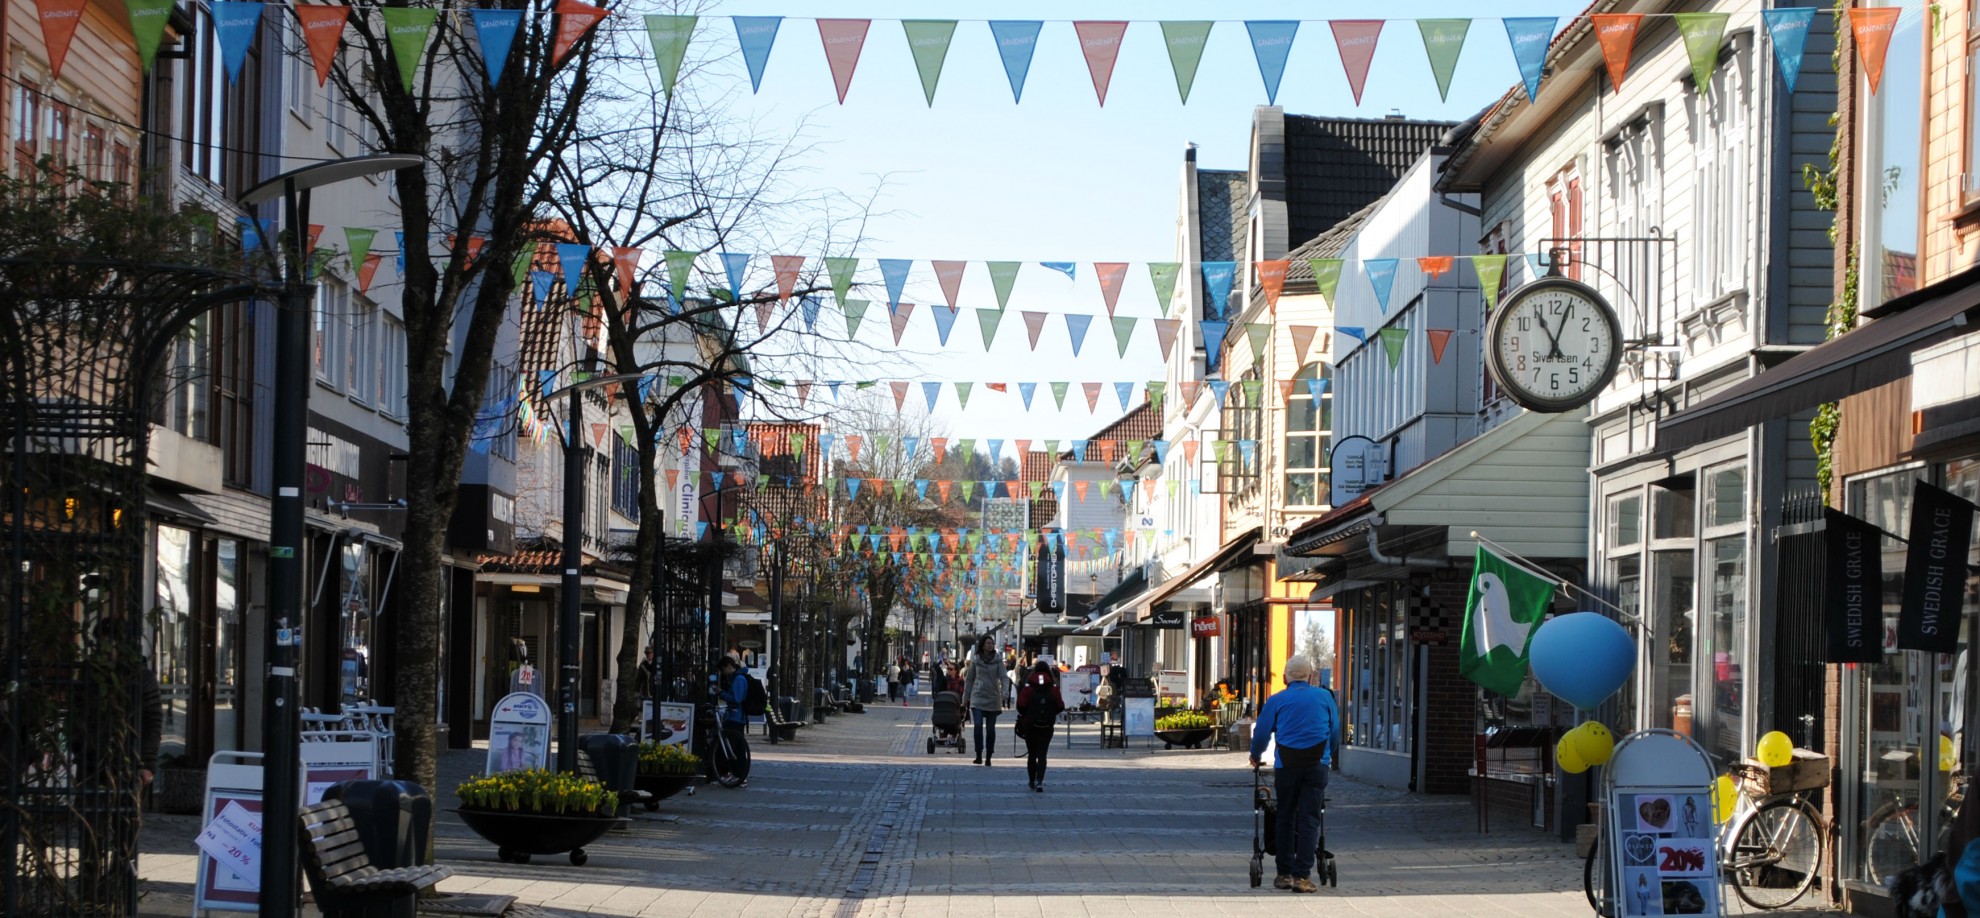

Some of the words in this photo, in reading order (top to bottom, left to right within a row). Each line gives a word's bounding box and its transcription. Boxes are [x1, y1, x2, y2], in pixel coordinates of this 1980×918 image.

[43, 10, 79, 18] SANDNES
[132, 7, 168, 17] SANDNES
[219, 18, 255, 27] SANDNES
[306, 19, 342, 29] SANDNES
[480, 19, 515, 29] SANDNES
[1601, 23, 1635, 33] SANDNES
[1773, 21, 1807, 33] SANDNES
[392, 25, 427, 34] SANDNES
[742, 25, 775, 33] SANDNES
[1687, 28, 1722, 39] SANDNES
[1857, 23, 1892, 34] SANDNES
[827, 35, 863, 44] SANDNES
[914, 37, 948, 46] SANDNES
[1001, 37, 1035, 46] SANDNES
[1085, 38, 1120, 47] SANDNES
[1170, 36, 1205, 45] SANDNES
[1257, 37, 1291, 47] SANDNES
[1341, 36, 1375, 46] SANDNES
[1515, 33, 1549, 43] SANDNES
[1532, 304, 1543, 319] 11
[1549, 300, 1562, 315] 12
[1518, 316, 1531, 331] 10
[1582, 317, 1591, 332] 2
[1511, 336, 1519, 352] 9
[1591, 337, 1599, 353] 3
[1517, 355, 1526, 370] 8
[1582, 356, 1593, 372] 4
[1533, 367, 1541, 383] 7
[1569, 367, 1578, 383] 5
[1551, 373, 1560, 390] 6
[1272, 527, 1288, 538] 40
[1930, 507, 1952, 560] GRACE
[1846, 531, 1862, 579] GRACE
[1922, 565, 1944, 635] SWEDISH
[1847, 584, 1862, 648] SWEDISH
[1194, 621, 1217, 631] håret
[219, 815, 247, 837] Fotostativ
[228, 846, 241, 859] 20
[241, 855, 251, 866] %
[1659, 846, 1705, 871] 20%
